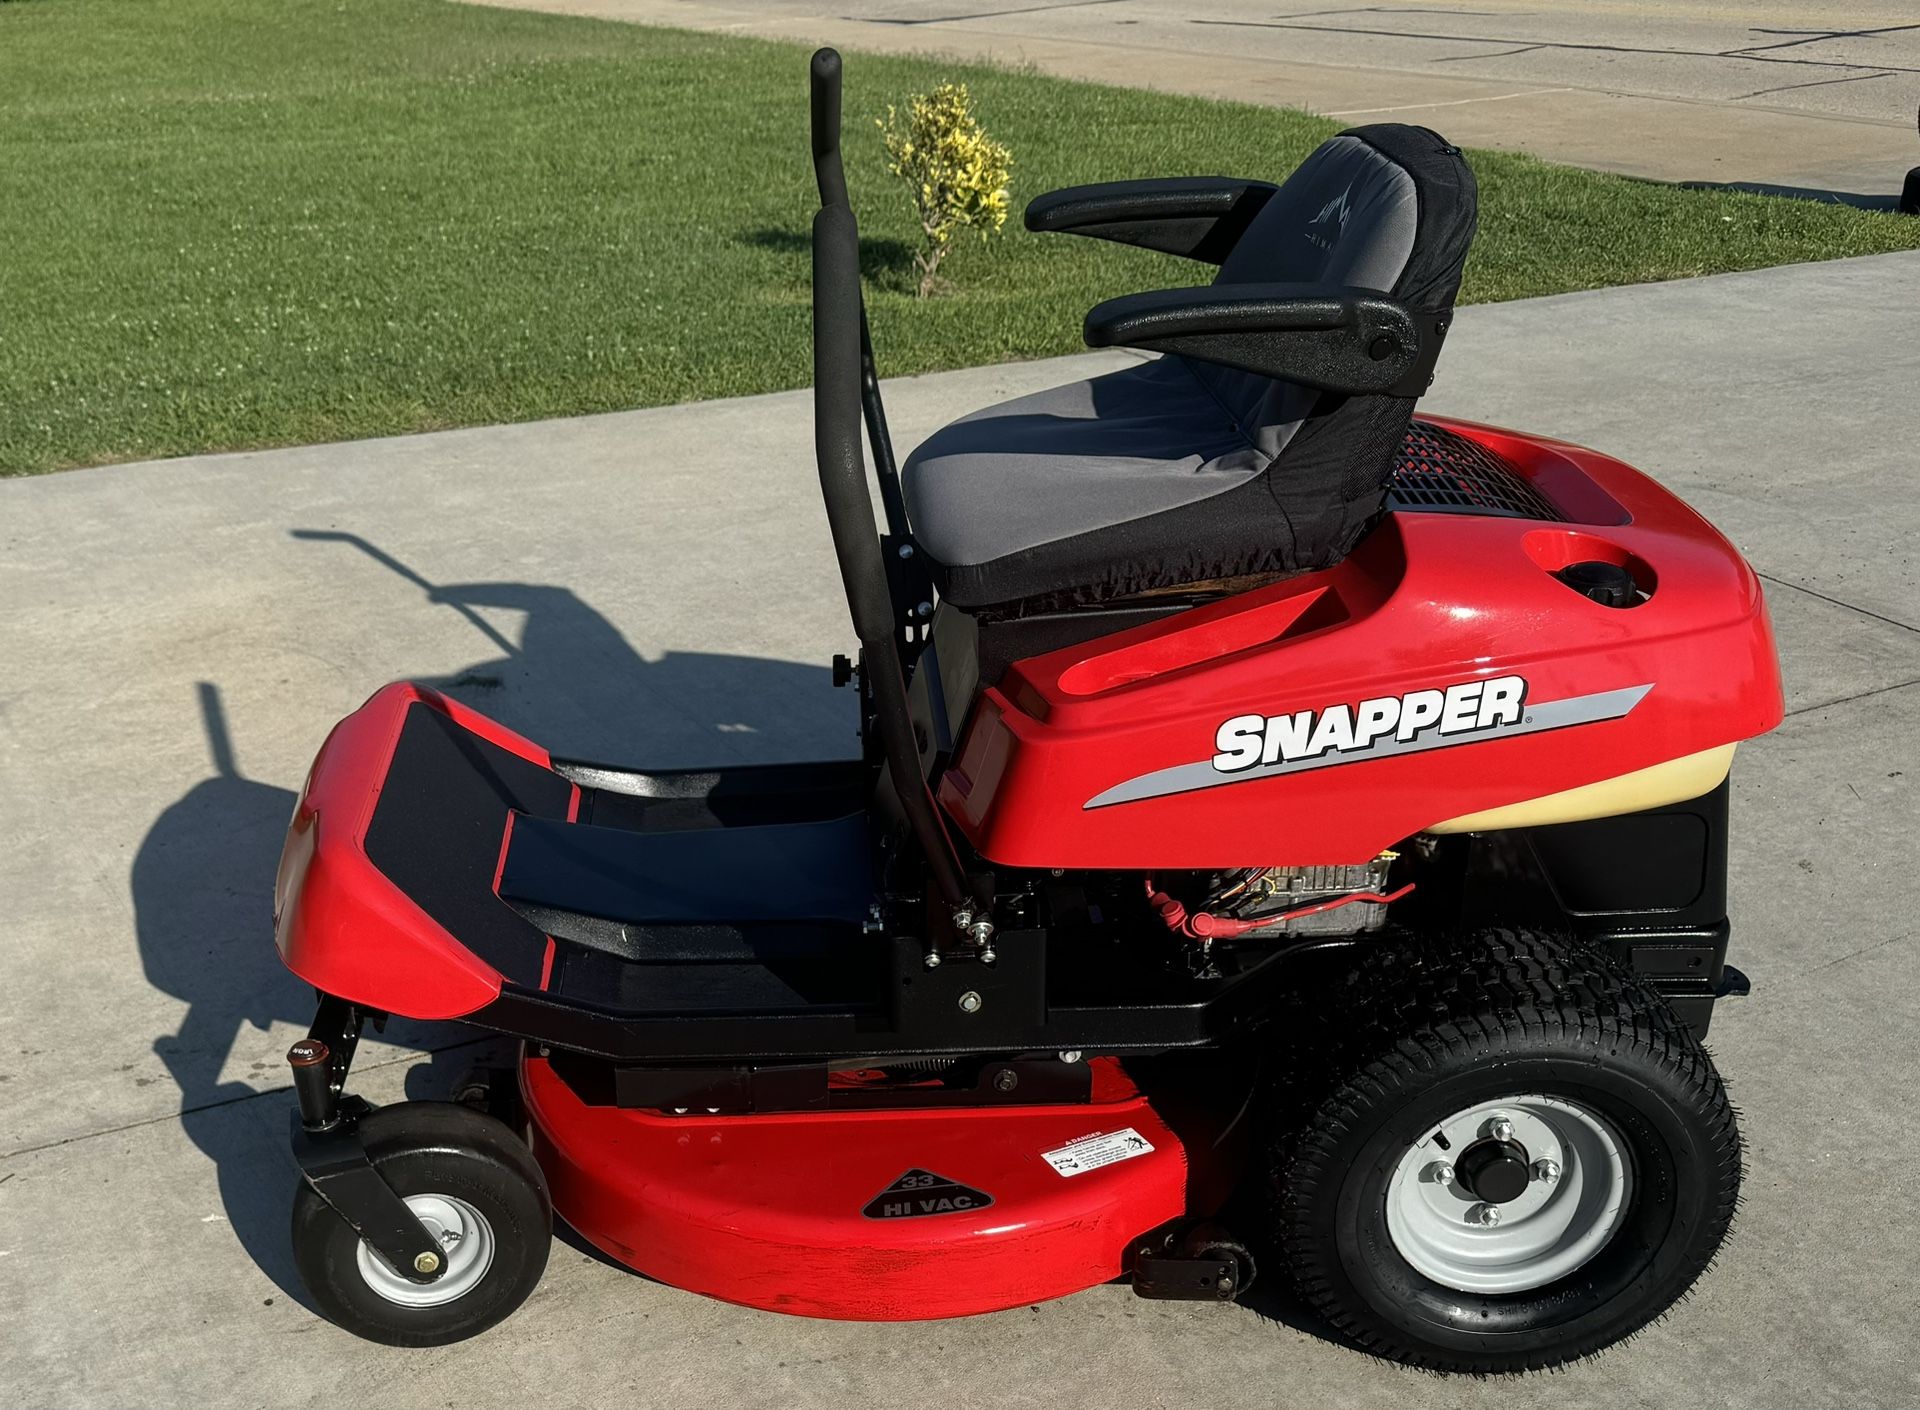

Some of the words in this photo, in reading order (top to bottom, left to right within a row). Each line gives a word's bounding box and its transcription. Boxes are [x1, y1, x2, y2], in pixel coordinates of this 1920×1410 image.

[1212, 675, 1529, 774] SNAPPER
[1072, 1131, 1102, 1144] DANGER
[901, 1174, 935, 1189] 33
[884, 1202, 911, 1217] HI
